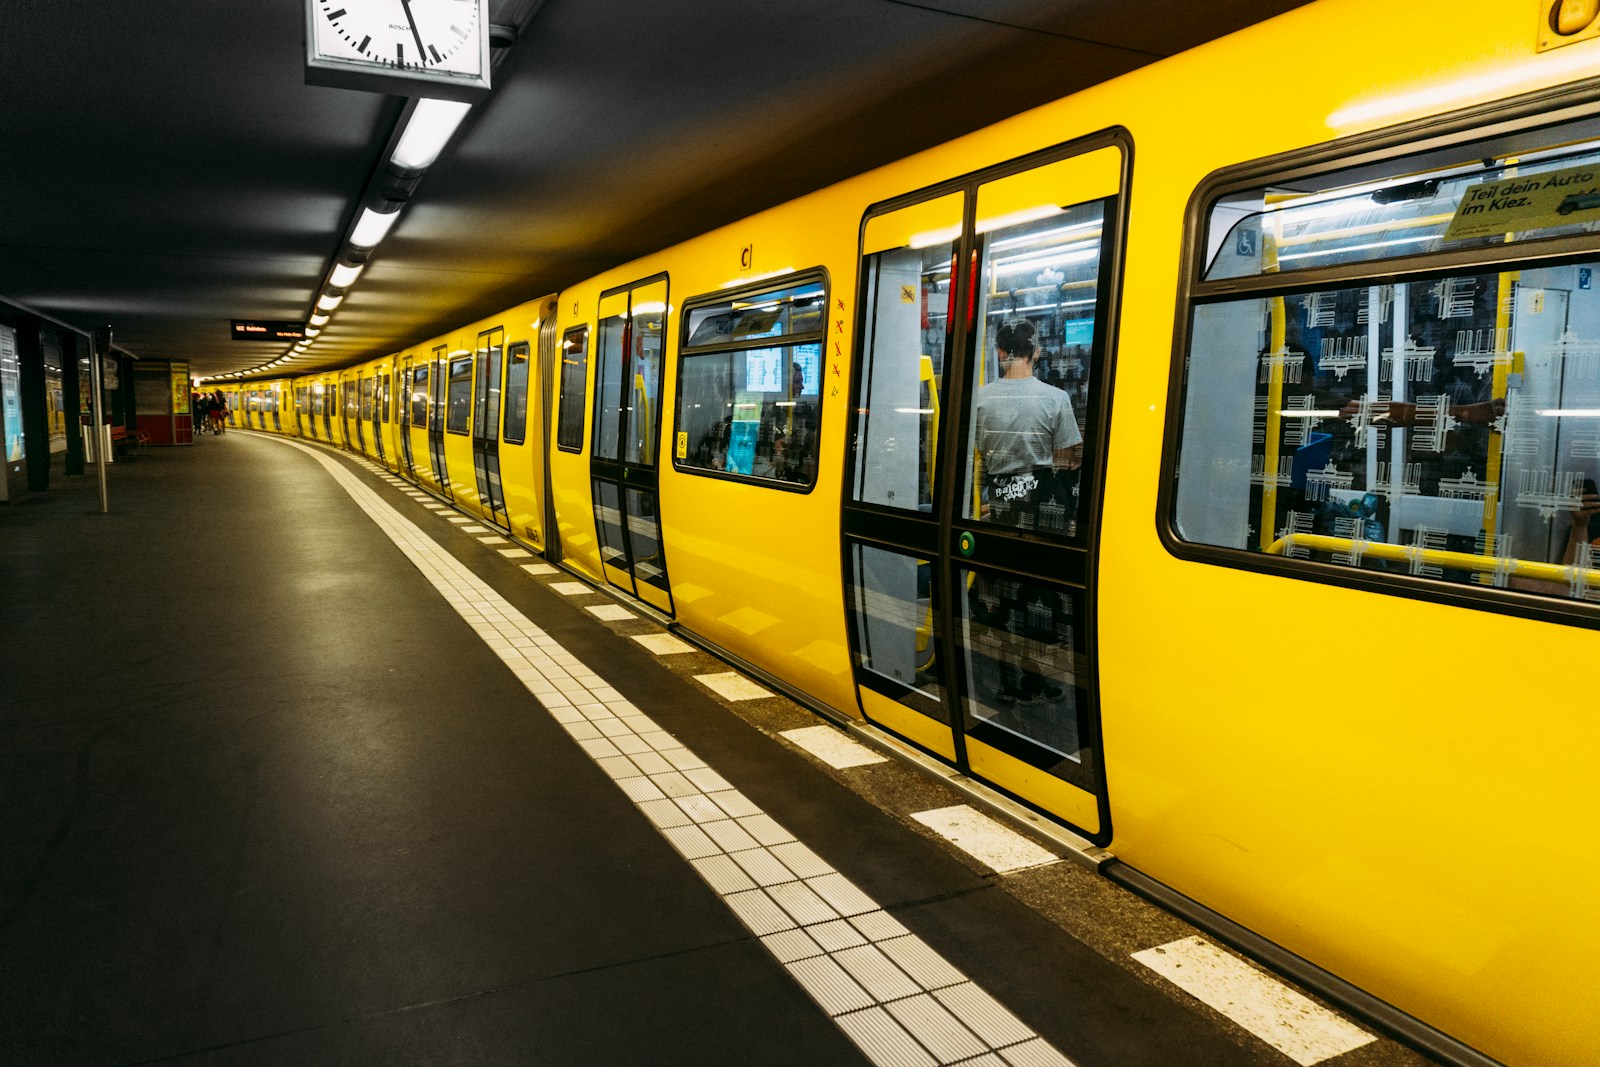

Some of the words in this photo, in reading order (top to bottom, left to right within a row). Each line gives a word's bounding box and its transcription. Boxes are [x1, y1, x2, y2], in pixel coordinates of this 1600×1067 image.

[1470, 185, 1498, 202] Teil
[1500, 179, 1539, 196] dein
[1543, 171, 1594, 190] Auto
[1462, 203, 1484, 216] im
[1488, 196, 1532, 212] Kiez.
